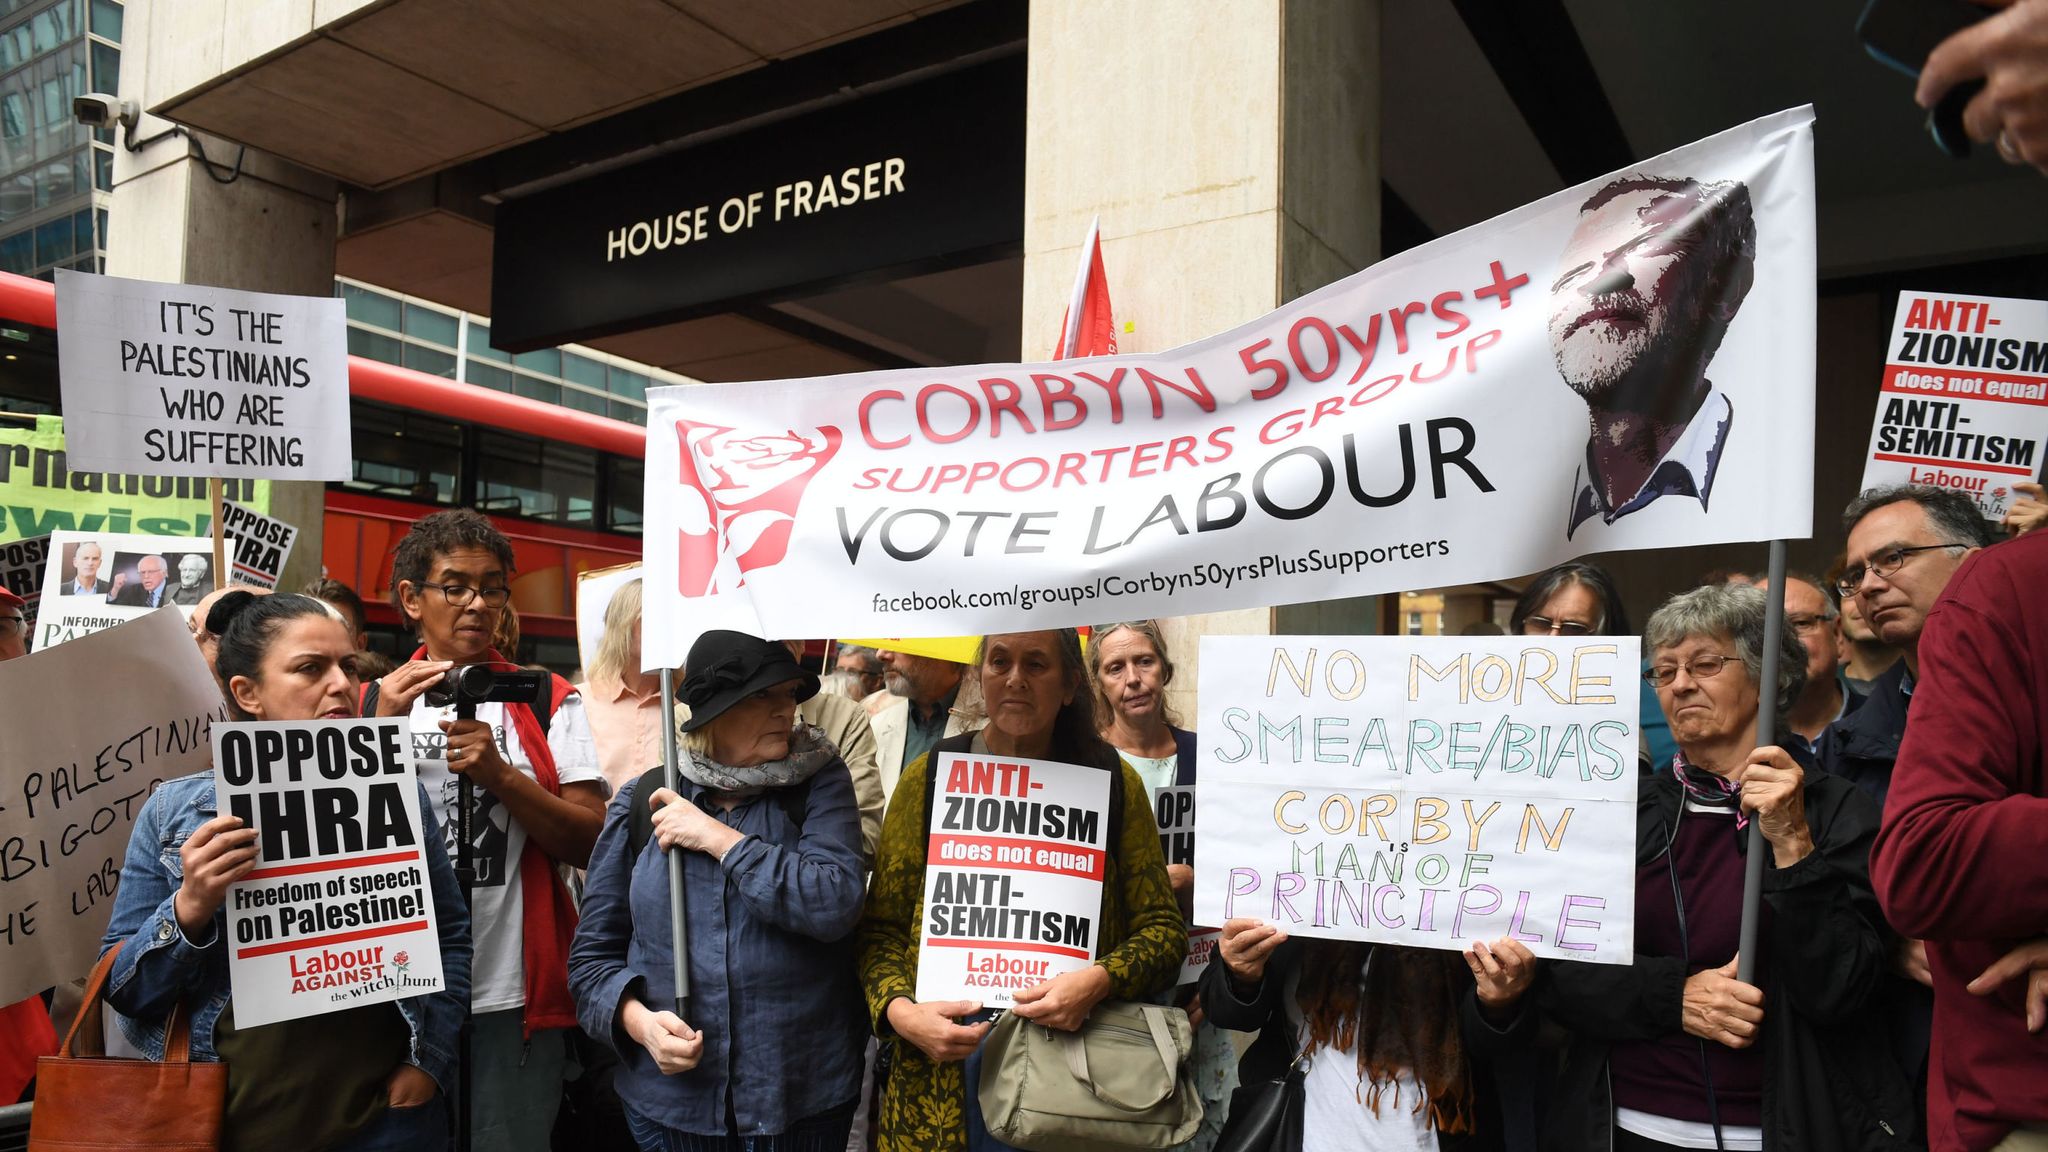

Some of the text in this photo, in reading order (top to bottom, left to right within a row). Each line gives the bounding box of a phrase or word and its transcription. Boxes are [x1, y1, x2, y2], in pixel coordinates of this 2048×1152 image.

[607, 157, 906, 262] HOUSE OF FRASER
[160, 300, 284, 345] IT'S THE
[1904, 298, 2001, 334] ANTI-
[120, 340, 311, 388] PALESTINIANS
[858, 366, 1216, 450] CORBYN
[1238, 260, 1530, 400] 50yrs+
[1898, 331, 2048, 374] ZIONISM
[160, 387, 284, 427] WHO ARE
[1894, 370, 2046, 400] does not equal
[852, 329, 1502, 494] SUPPORTERS GROUP
[1882, 398, 1971, 431] ANTI-
[144, 428, 304, 467] SUFFERING
[1877, 425, 2036, 467] SEMITISM
[835, 416, 1497, 566] VOTE LABOUR
[1908, 467, 1989, 491] Labour
[222, 502, 293, 548] OPPOSE
[872, 538, 1450, 614] facebook.com/groups/Corbyn50yrsPlusSupporters
[1265, 644, 1618, 706] NO MORE
[221, 725, 405, 786] OPPOSE
[1214, 706, 1630, 782] SMEARE/BIAS
[945, 759, 1043, 798] ANTI-
[230, 782, 416, 863] IHRA
[941, 796, 1098, 845] ZIONISM
[1274, 789, 1575, 854] CORBYN
[940, 840, 1094, 874] does not equal
[1291, 840, 1494, 888] MAN OF
[235, 866, 421, 910] Freedom of speech
[931, 871, 1024, 907] ANTI-
[1224, 866, 1606, 952] PRINCIPLE
[236, 888, 426, 944] on Palestine!
[929, 904, 1091, 949] SEMITISM
[289, 946, 384, 978] Labour
[291, 965, 385, 995] AGAINST
[967, 952, 1050, 977] Labour
[331, 974, 438, 1002] the witch hunt
[995, 993, 1010, 1002] the
